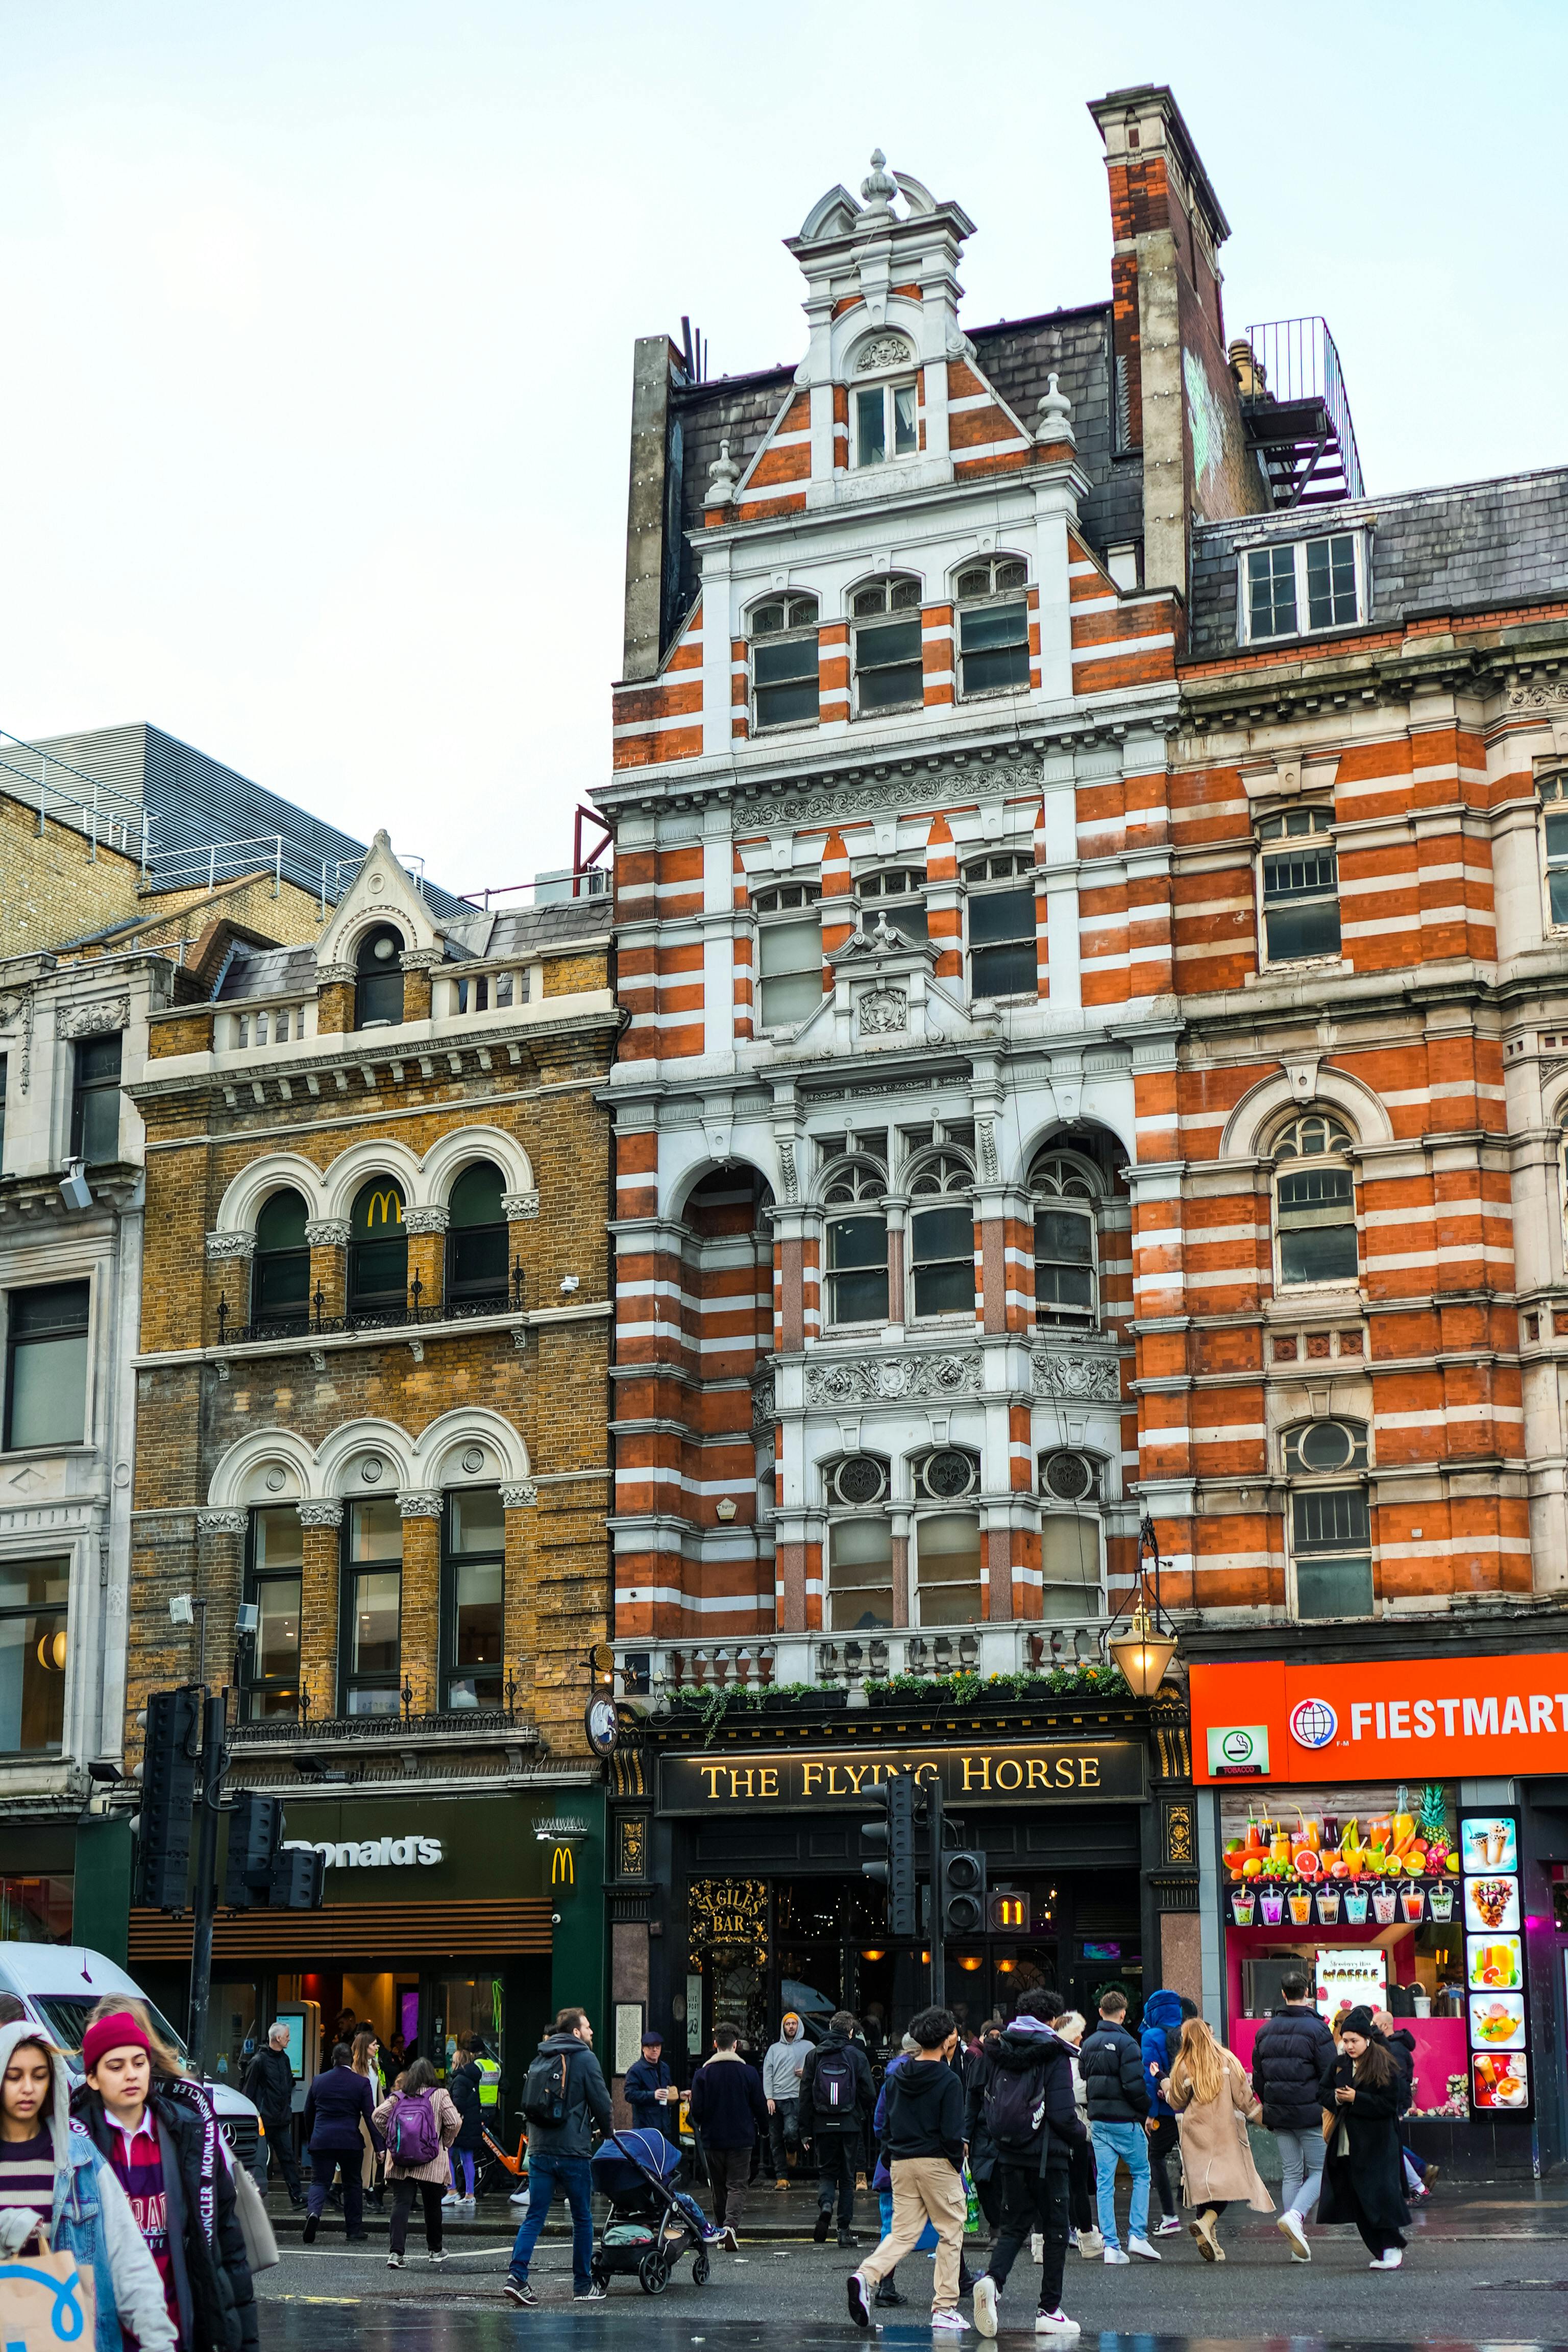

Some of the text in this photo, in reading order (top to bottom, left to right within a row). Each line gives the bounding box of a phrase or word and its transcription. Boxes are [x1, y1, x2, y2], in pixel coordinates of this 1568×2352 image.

[1351, 1694, 1568, 1741] FIESTMART
[700, 1766, 779, 1798] THE
[961, 1757, 1101, 1791] HORSE
[281, 1835, 443, 1868] onald's
[697, 1889, 762, 1915] ST GILES
[1001, 1901, 1021, 1924] 11
[713, 1915, 745, 1932] BAR
[1322, 1969, 1378, 1982] WAFFLE
[172, 2082, 212, 2122] MONCLER
[1032, 2100, 1045, 2122] NIKE
[200, 2185, 213, 2249] ONCLER
